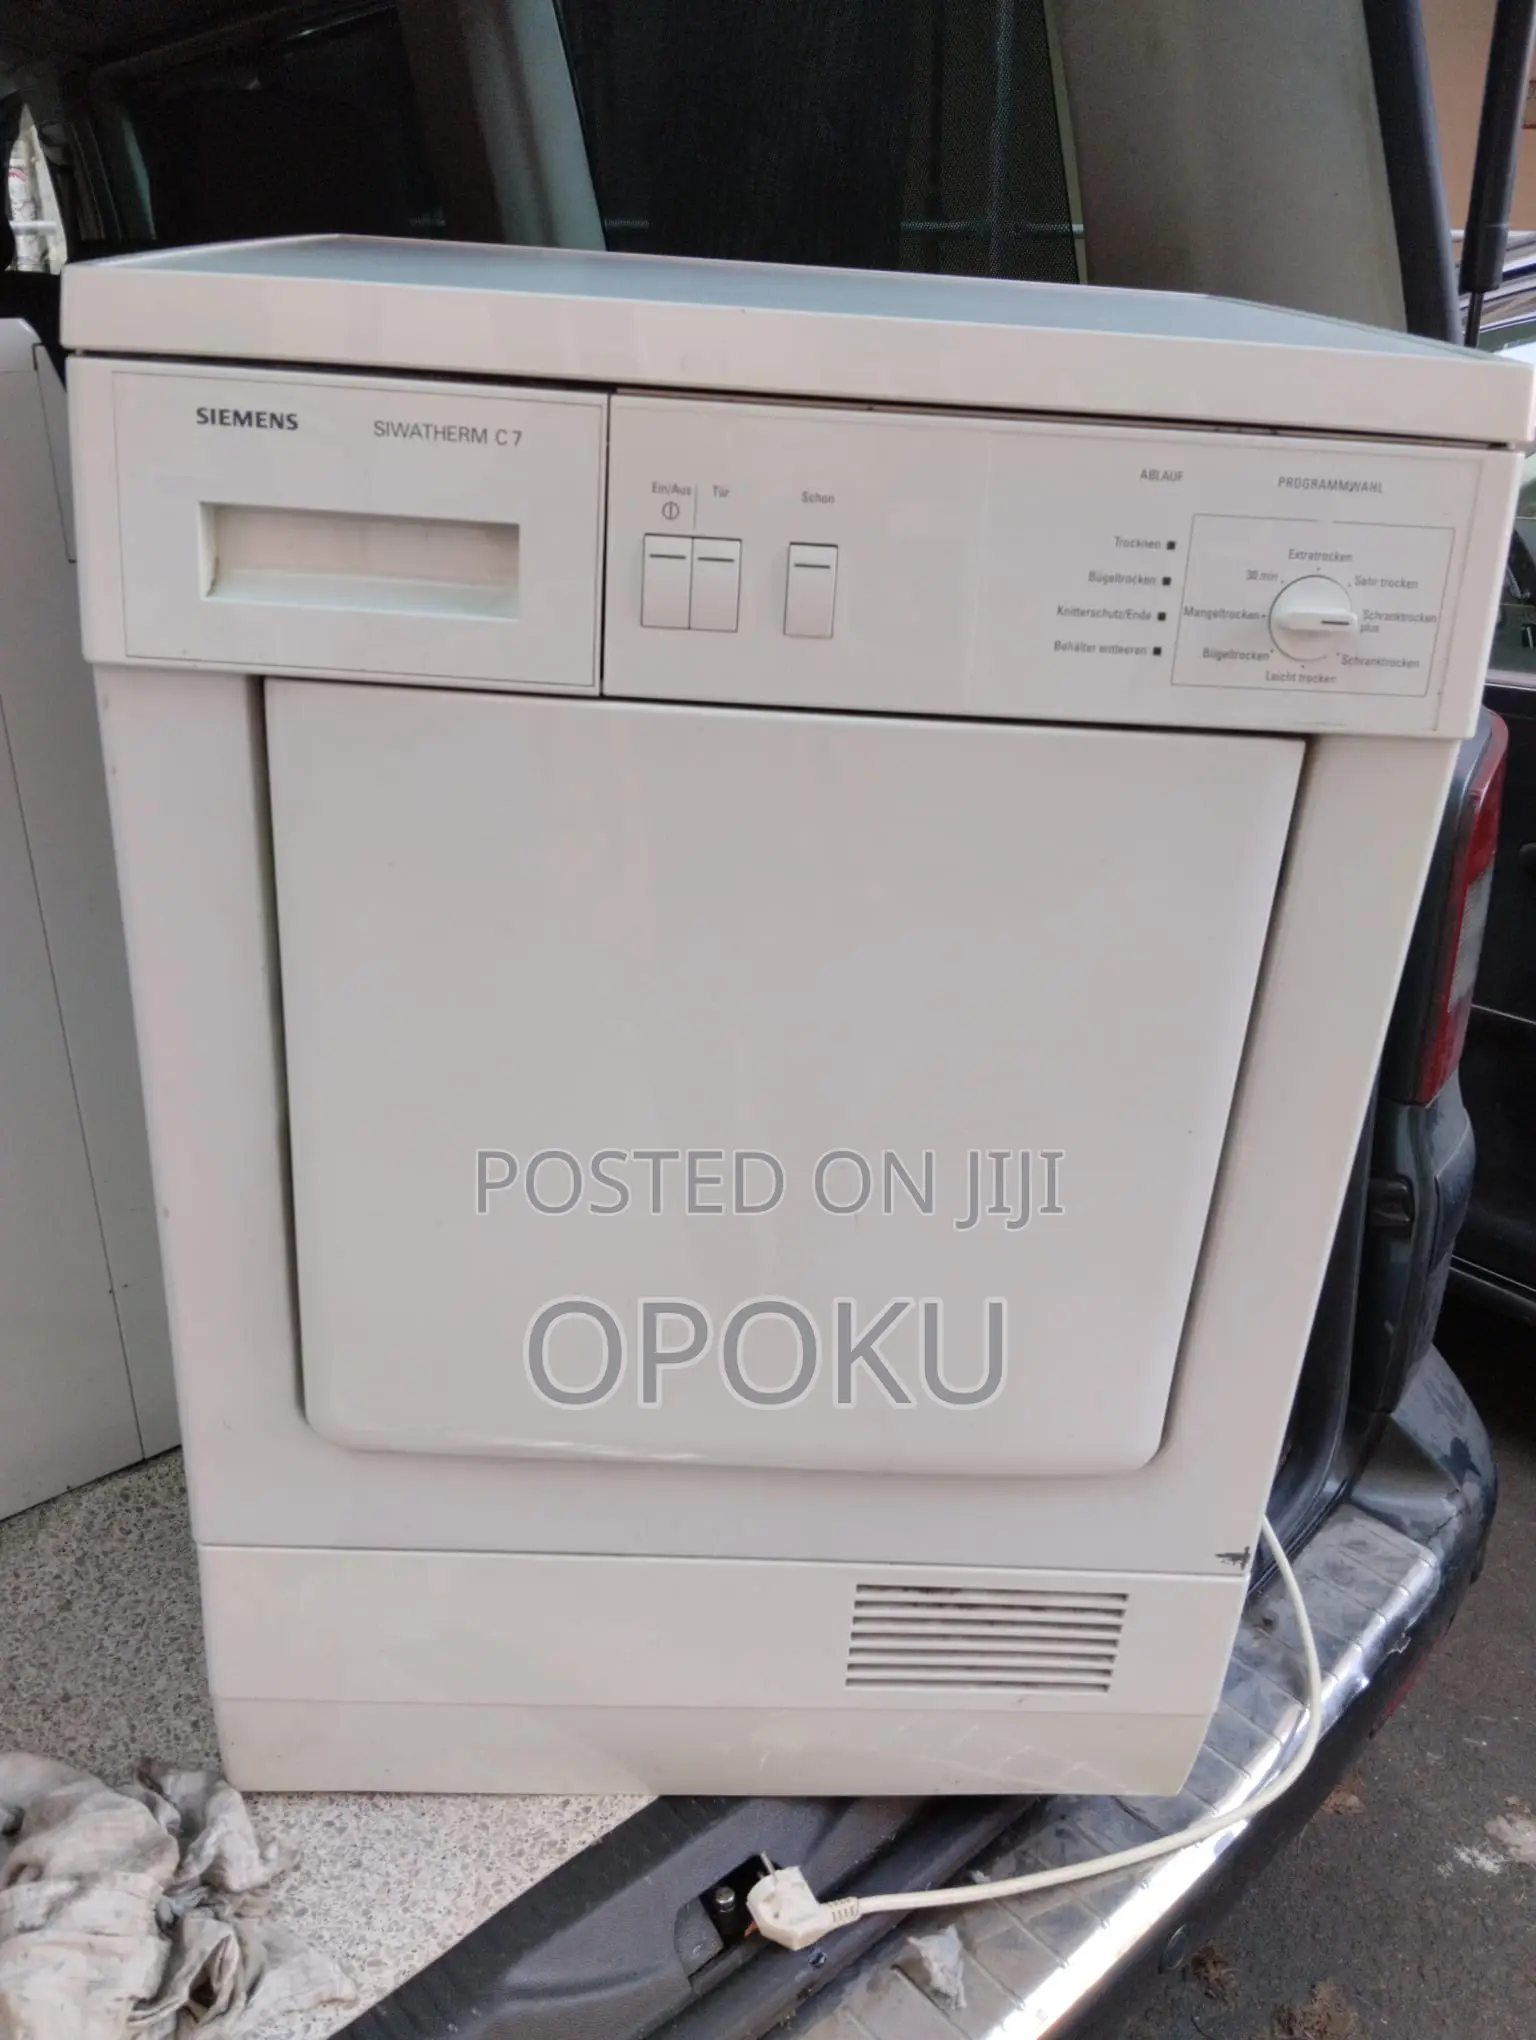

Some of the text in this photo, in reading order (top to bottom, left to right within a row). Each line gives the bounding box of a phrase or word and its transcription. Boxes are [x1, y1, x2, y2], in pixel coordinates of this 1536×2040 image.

[196, 407, 299, 431] SIEMENS
[373, 420, 522, 447] SIWATHERM C 7
[1140, 469, 1184, 482] ABLAUF
[651, 481, 692, 496] Ein/Aus
[713, 484, 730, 498] Tür
[1277, 476, 1383, 493] PROGRAMMWAHL
[801, 491, 835, 504] Schon
[1114, 536, 1161, 549] Trocknen
[1288, 549, 1353, 562] Extratrocken
[1088, 570, 1156, 586] Bügeltrocken
[1259, 572, 1278, 581] min
[1380, 577, 1418, 589] trocken
[1057, 604, 1151, 621] Knitterschutz/Ende
[1183, 605, 1260, 620] Mangeltrocken
[1362, 609, 1438, 623] Schranktrocken
[1360, 623, 1380, 634] plus
[1053, 640, 1147, 655] Behälter entleeren
[1202, 647, 1270, 661] Bügeltrocken
[1341, 654, 1420, 668] Schranktrocken
[1299, 673, 1337, 684] trocken
